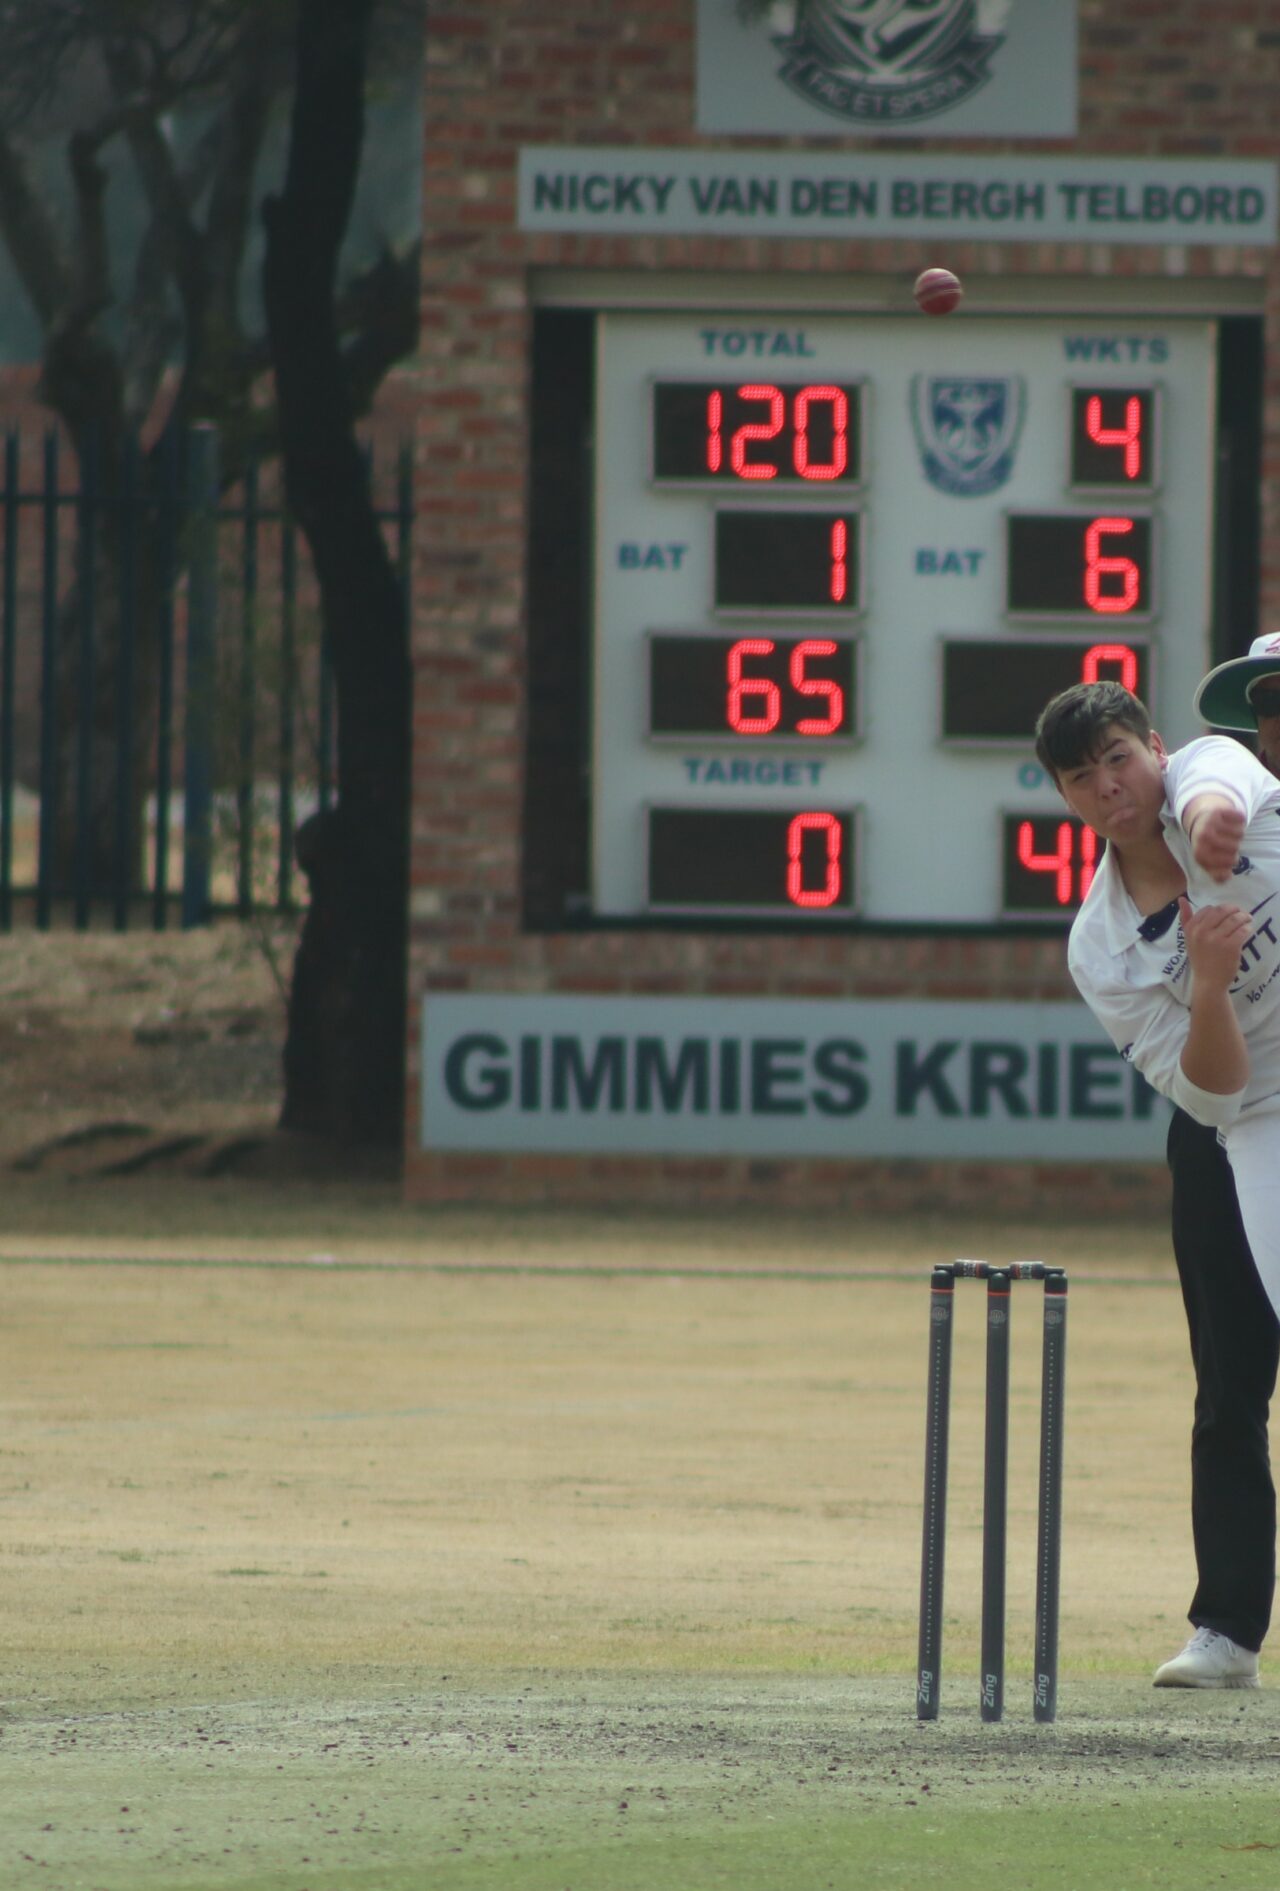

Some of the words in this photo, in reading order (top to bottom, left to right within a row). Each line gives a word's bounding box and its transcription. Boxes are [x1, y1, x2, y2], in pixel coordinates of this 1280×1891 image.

[809, 72, 849, 107] FAC
[853, 94, 883, 114] ET
[534, 174, 676, 214] NICKY
[688, 177, 778, 217] VAN
[790, 179, 878, 218] DEN
[890, 180, 1046, 221] BERGH
[1056, 183, 1266, 225] TELBORD
[700, 329, 816, 358] TOTAL
[1063, 335, 1169, 363] WKTS
[706, 384, 849, 480] 120
[1085, 396, 1141, 479] 4
[617, 544, 688, 570] BAT
[830, 519, 847, 602] 1
[915, 549, 986, 576] BAT
[1084, 517, 1140, 613] 6
[726, 639, 844, 735] 65
[684, 758, 826, 787] TARGET
[786, 812, 842, 907] 0
[443, 1032, 871, 1118] GIMMIES
[918, 1670, 934, 1705] Zing
[983, 1673, 998, 1708] Zing
[1035, 1673, 1050, 1708] Zing
